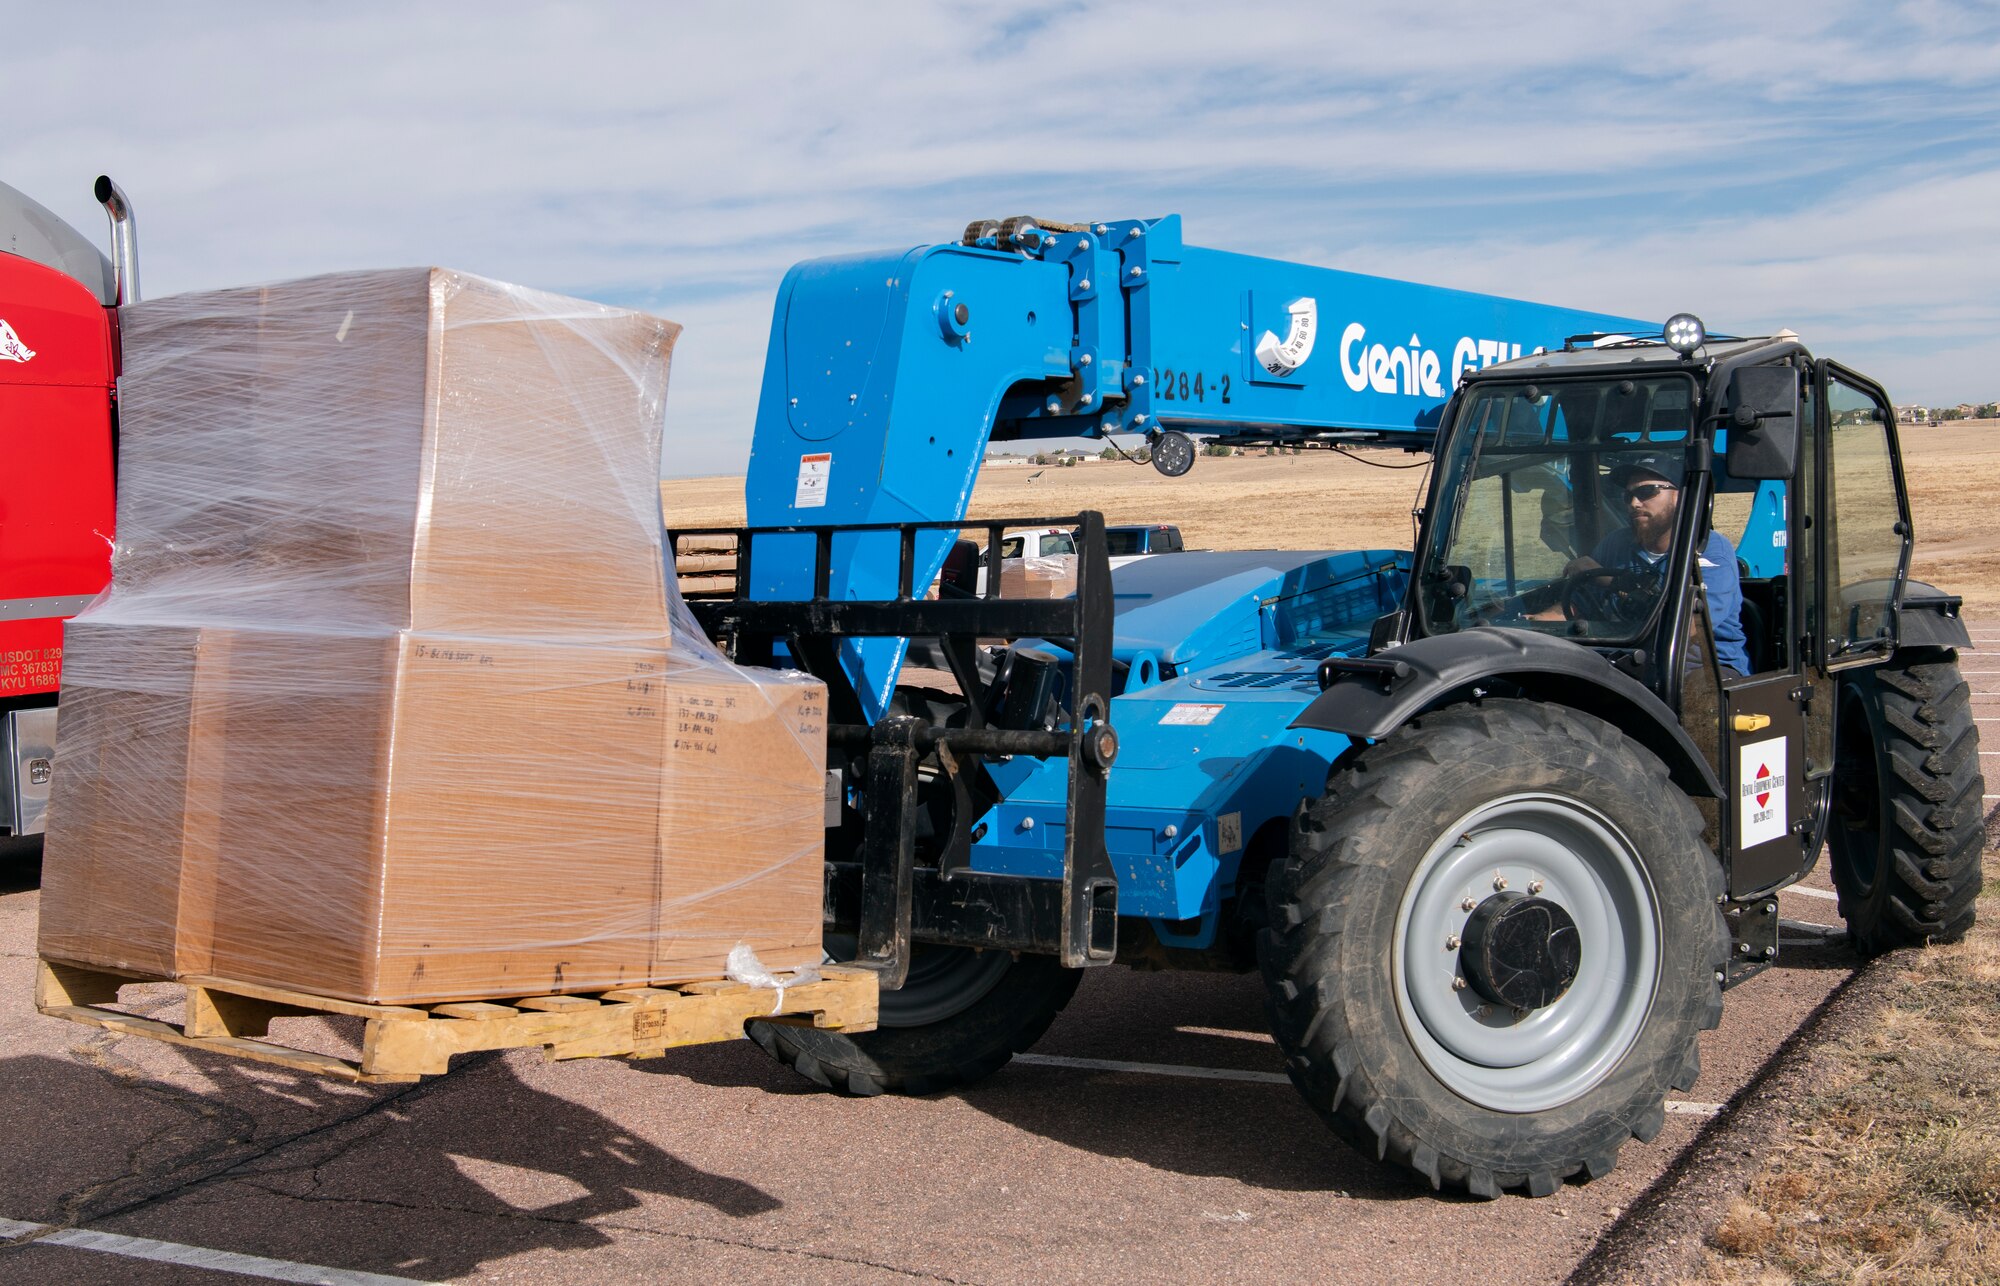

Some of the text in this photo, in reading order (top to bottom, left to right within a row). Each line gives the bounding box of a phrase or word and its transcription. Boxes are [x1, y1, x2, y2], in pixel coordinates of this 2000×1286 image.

[1301, 318, 1310, 328] 80
[1299, 331, 1308, 341] 60
[1295, 341, 1304, 349] 40
[1340, 322, 1441, 398] Genie
[1267, 363, 1282, 374] -20
[0, 648, 63, 663] USDOT 829
[0, 661, 59, 676] MC 367831
[1, 673, 61, 689] KYU 16861
